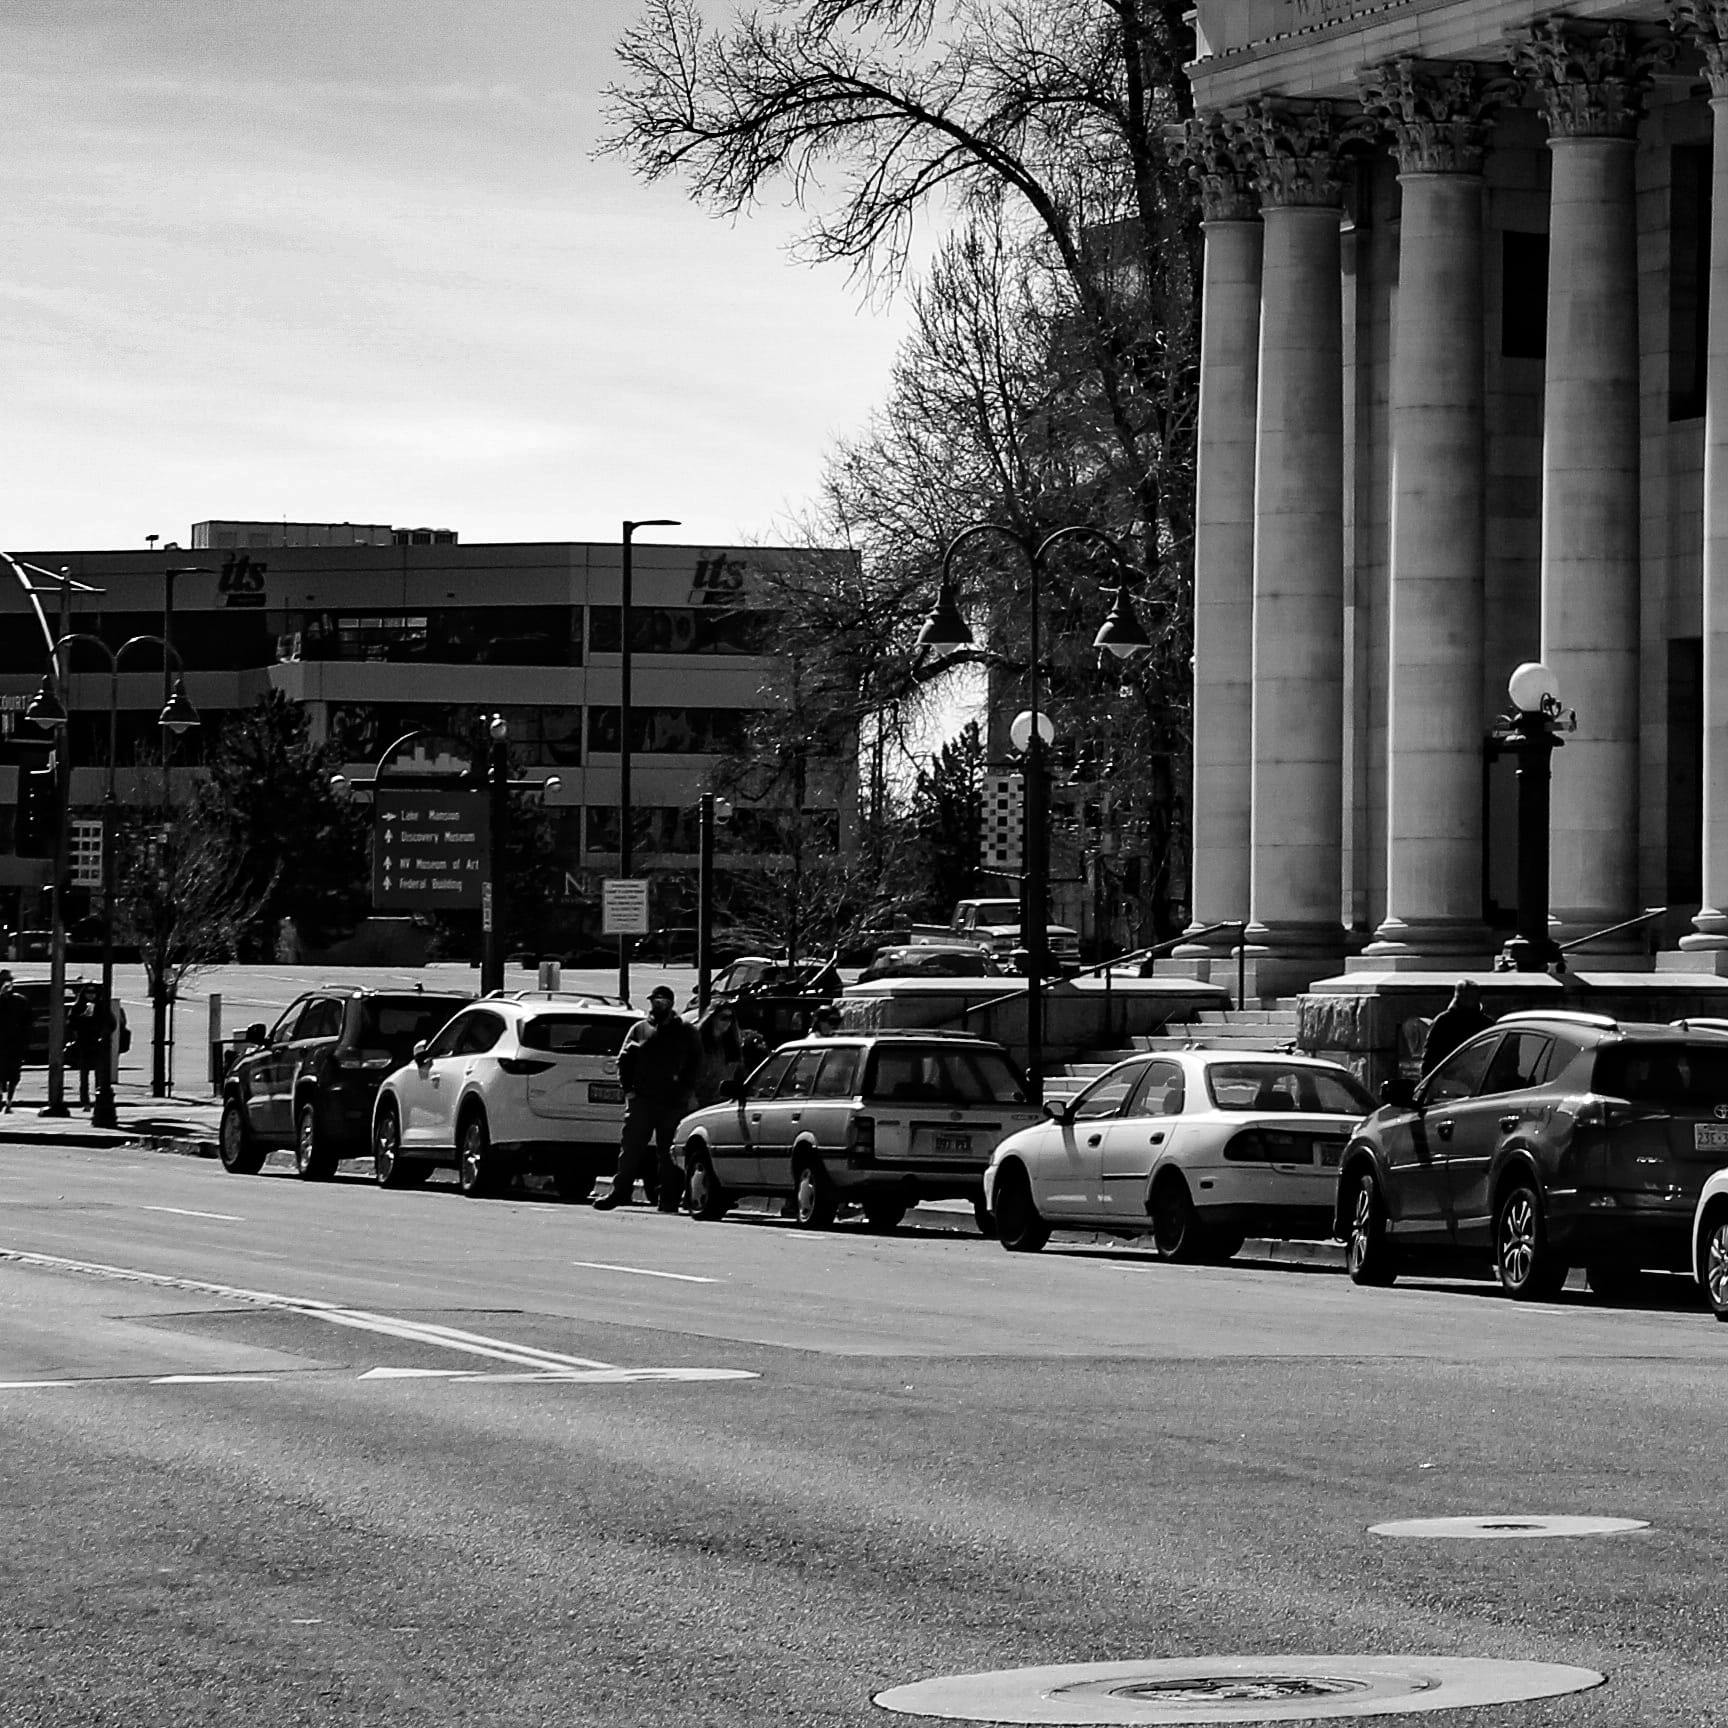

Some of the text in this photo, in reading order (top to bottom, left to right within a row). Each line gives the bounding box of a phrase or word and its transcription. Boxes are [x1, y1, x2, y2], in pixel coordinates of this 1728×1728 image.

[444, 831, 475, 842] Museum
[416, 858, 447, 870] Museum
[452, 858, 461, 870] of
[466, 858, 480, 870] Art
